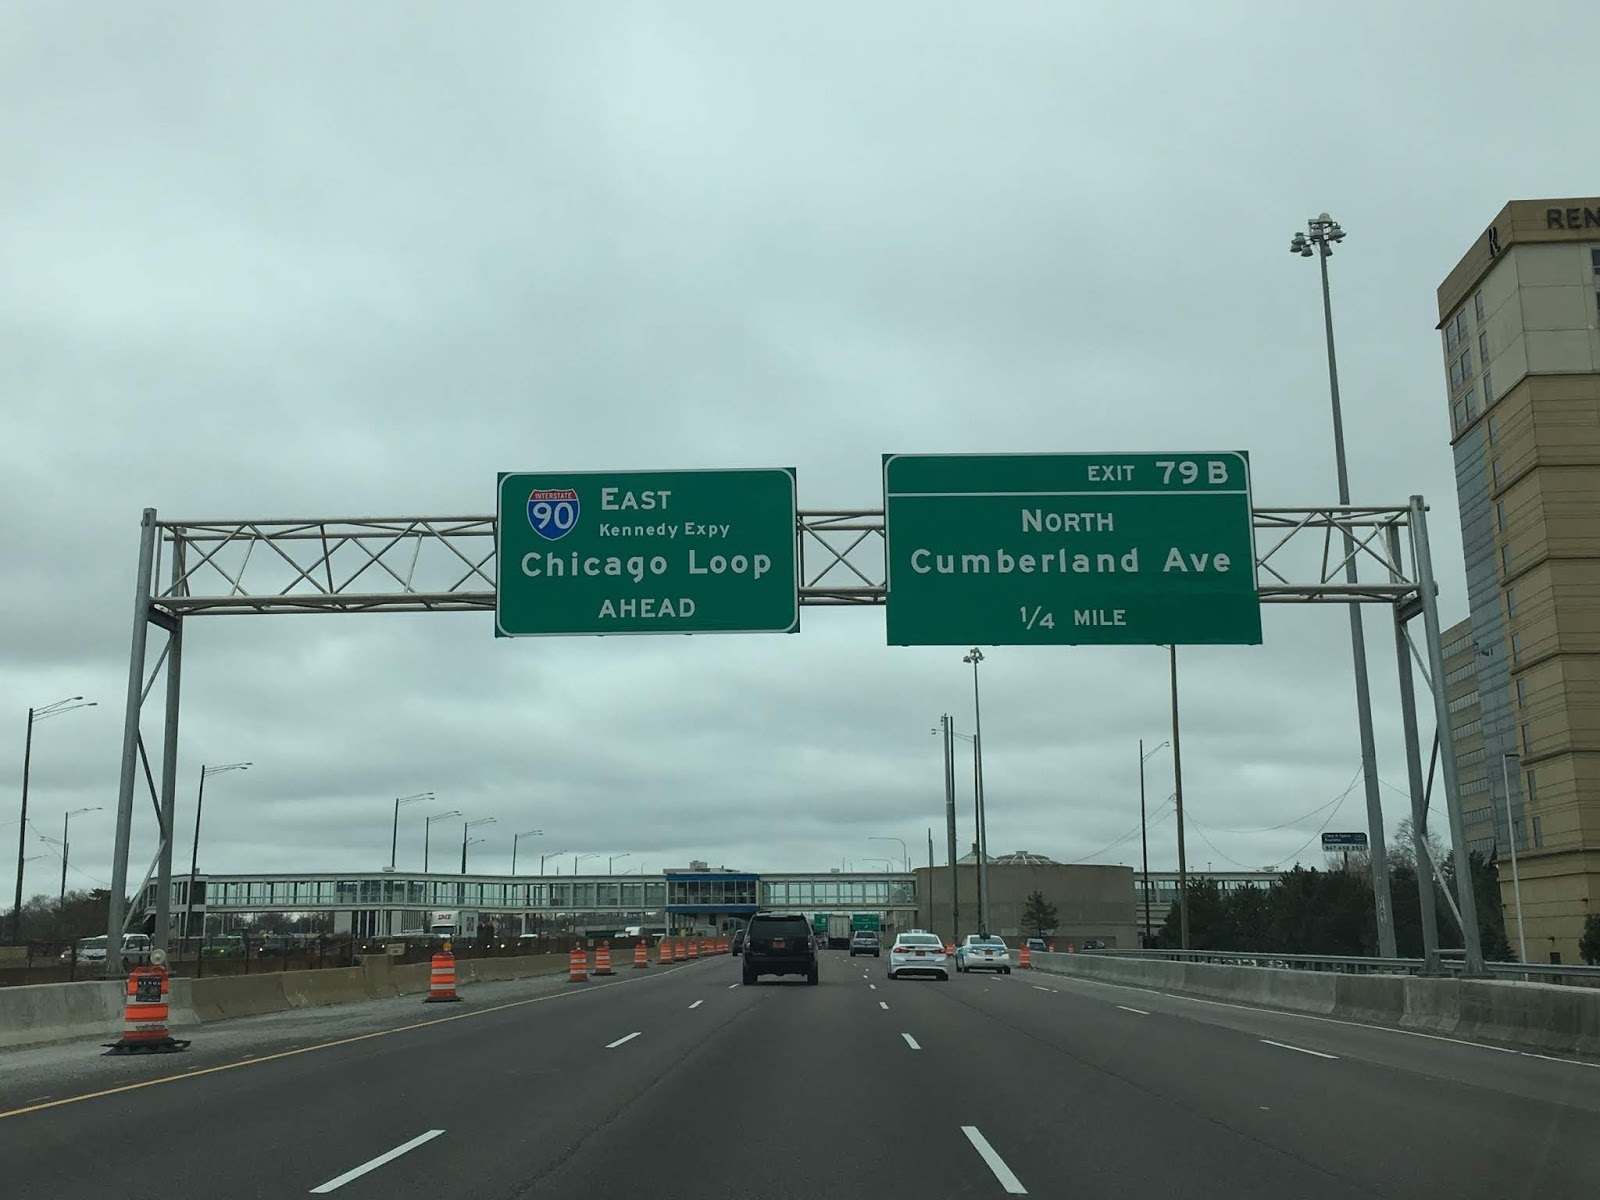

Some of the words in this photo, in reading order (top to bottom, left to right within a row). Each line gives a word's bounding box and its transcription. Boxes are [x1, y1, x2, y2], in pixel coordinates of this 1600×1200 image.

[1088, 466, 1134, 480] EXIT
[1156, 462, 1198, 483] 79
[1208, 462, 1227, 483] B
[602, 488, 671, 510] EAST
[533, 502, 574, 530] 90
[1022, 510, 1113, 531] NORTH
[600, 523, 677, 538] Kennedy
[686, 523, 729, 537] Expy
[522, 552, 666, 582] Chicago
[690, 550, 770, 579] Loop
[911, 548, 1138, 573] Cumberland
[1163, 548, 1230, 571] Ave
[599, 599, 695, 618] AHEAD
[1021, 606, 1054, 629] 1/4
[1075, 610, 1126, 625] MILE
